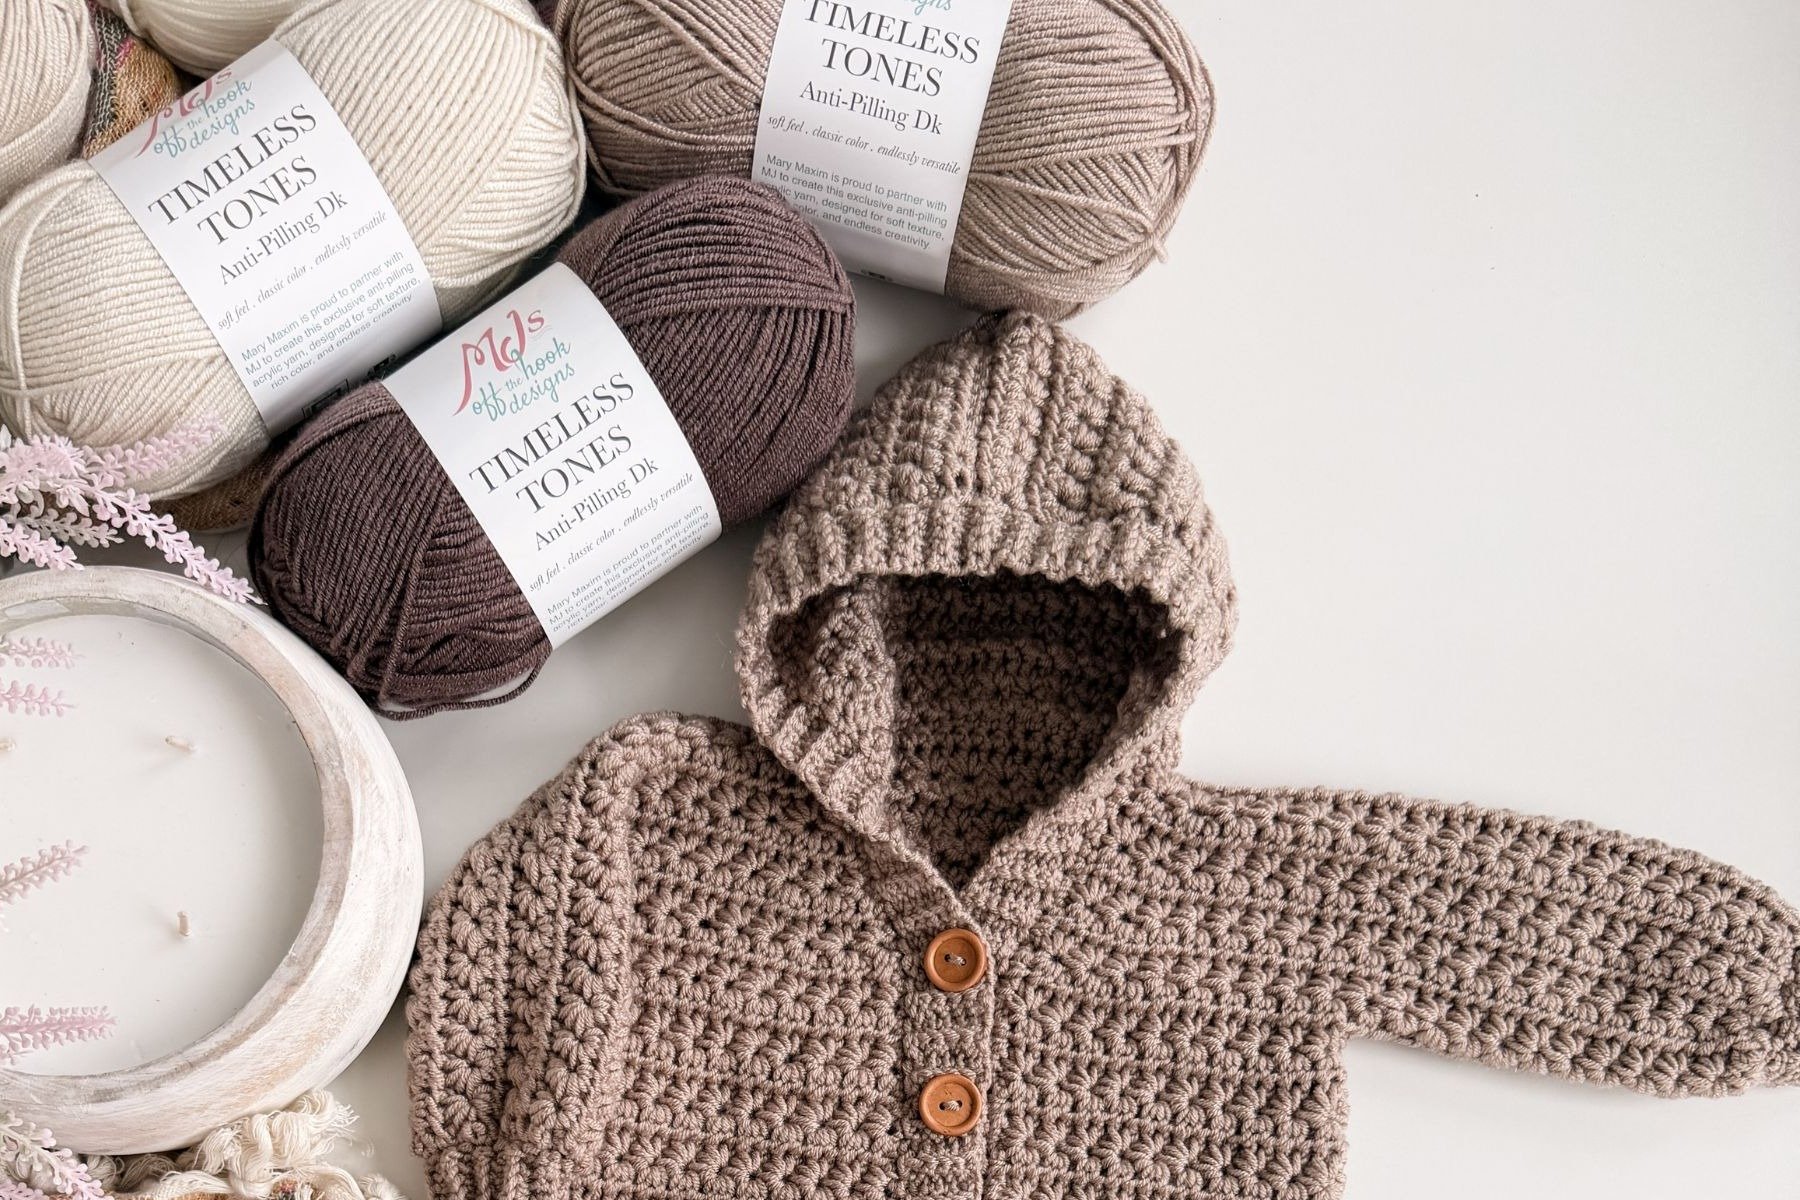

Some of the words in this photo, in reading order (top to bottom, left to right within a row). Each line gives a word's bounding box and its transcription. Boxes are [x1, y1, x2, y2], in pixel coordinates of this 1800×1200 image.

[802, 0, 980, 64] TIMELESS
[821, 38, 943, 97] TONES
[799, 80, 910, 132] Anti-Pilling
[913, 109, 943, 135] Dk
[147, 103, 317, 224] TIMELESS
[767, 115, 786, 130] soft
[781, 116, 805, 133] feel
[811, 125, 844, 143] classic
[844, 136, 870, 151] color
[877, 144, 920, 165] endlessly
[921, 157, 961, 175] versatile
[196, 155, 317, 245] TONES
[761, 165, 778, 179] MJ
[779, 171, 790, 183] to
[791, 176, 824, 192] create
[826, 185, 845, 199] this
[846, 192, 894, 212] exclusive
[895, 206, 948, 230] anti-pilling
[766, 153, 793, 172] Mary
[794, 161, 829, 180] Maxim
[830, 172, 840, 184] is
[841, 176, 873, 192] proud
[874, 184, 885, 196] to
[886, 189, 925, 206] partner
[926, 199, 948, 213] with
[220, 212, 321, 286] Anti-Pilling
[314, 191, 348, 219] Dk
[352, 210, 387, 240] versatile
[792, 190, 819, 206] yarn,
[821, 198, 869, 218] designed
[870, 210, 884, 222] for
[885, 217, 905, 229] soft
[907, 221, 945, 242] texture,
[821, 211, 842, 224] and
[841, 217, 883, 236] endless
[286, 264, 307, 285] color
[314, 234, 352, 266] endlessly
[218, 310, 240, 330] soft
[227, 298, 251, 324] feel
[241, 341, 267, 362] Mary
[266, 320, 300, 346] Maxim
[299, 313, 310, 325] is
[309, 292, 339, 320] proud
[337, 288, 349, 299] to
[349, 264, 383, 294] partner
[383, 251, 405, 269] with
[245, 359, 262, 376] MJ
[261, 354, 273, 366] to
[273, 335, 304, 358] create
[303, 322, 323, 338] this
[323, 294, 367, 327] exclusive
[366, 262, 415, 298] anti-pilling
[257, 279, 285, 304] classic
[252, 364, 284, 388] acrylic
[283, 349, 309, 370] yarn,
[308, 317, 352, 352] designed
[351, 310, 365, 324] for
[366, 297, 386, 315] soft
[384, 277, 421, 305] texture,
[468, 372, 634, 493] TIMELESS
[515, 424, 632, 512] TONES
[529, 574, 549, 592] soft
[539, 562, 561, 585] feel
[567, 542, 594, 566] classic
[596, 527, 615, 546] color
[623, 497, 659, 528] endlessly
[660, 472, 693, 502] versatile
[535, 479, 632, 552] Anti-Pilling
[628, 457, 659, 484] Dk
